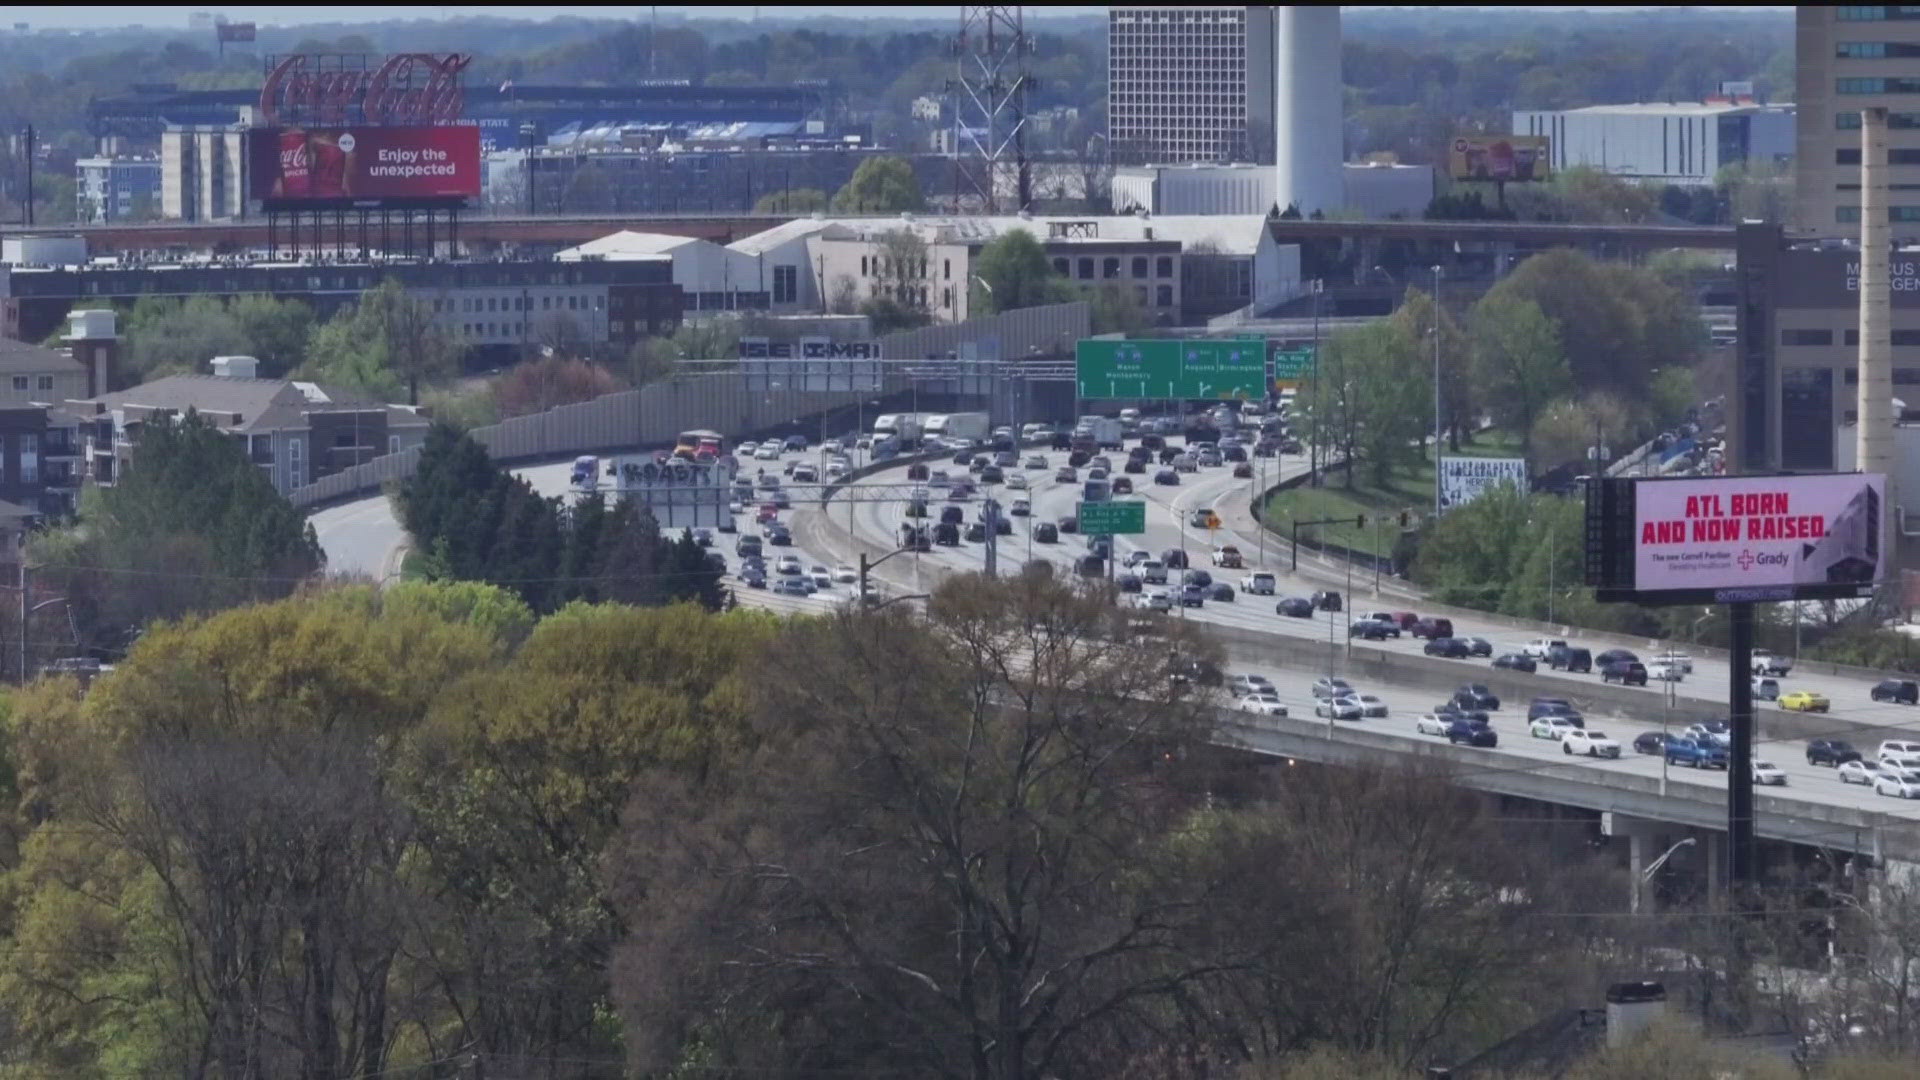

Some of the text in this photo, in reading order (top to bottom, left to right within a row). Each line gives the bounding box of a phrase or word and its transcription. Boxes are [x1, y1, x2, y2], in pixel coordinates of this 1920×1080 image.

[378, 148, 447, 164] Enjoy the
[370, 162, 456, 178] unexpected
[1685, 493, 1789, 518] ATL BORN
[1642, 521, 1685, 544] AND
[1693, 518, 1740, 542] NOW
[1652, 553, 1664, 562] The
[1756, 552, 1789, 566] Grady
